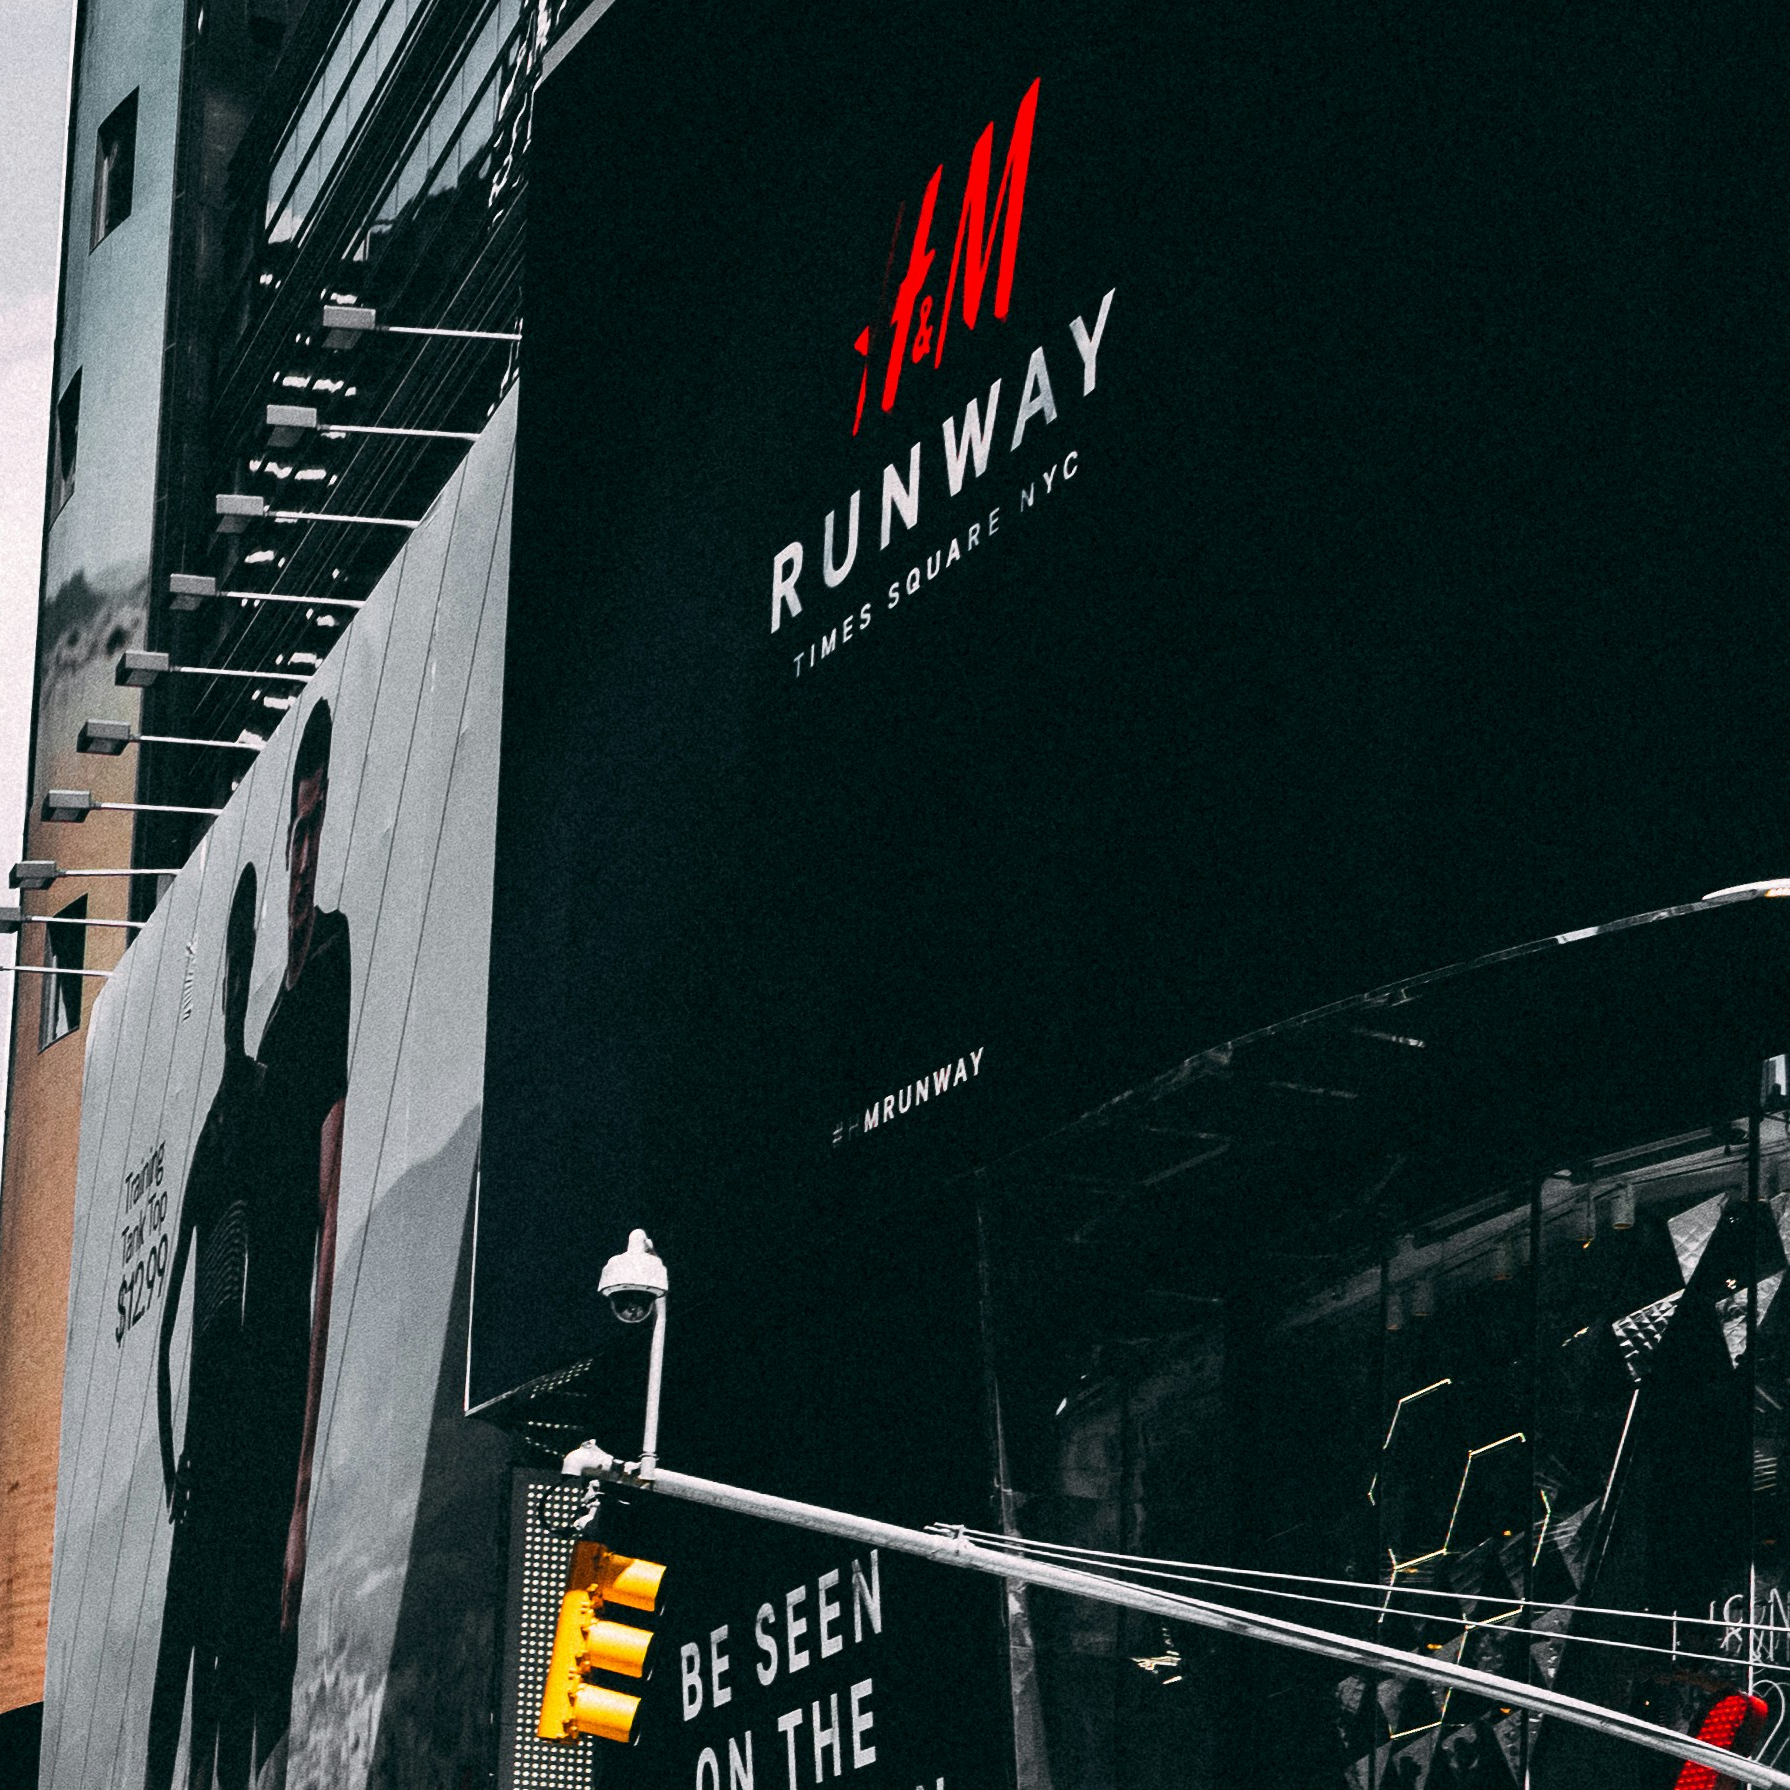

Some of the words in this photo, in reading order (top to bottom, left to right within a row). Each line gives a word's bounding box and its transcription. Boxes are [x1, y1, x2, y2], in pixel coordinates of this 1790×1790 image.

[851, 77, 1041, 436] H&M
[770, 287, 1116, 634] RUNWAY
[793, 604, 872, 678] TIMES
[887, 507, 1000, 610] SQUARE
[1019, 450, 1079, 513] NYC
[120, 1205, 149, 1268] Tank
[147, 1189, 168, 1239] Top
[124, 1140, 166, 1214] Training
[680, 1623, 731, 1724] BE
[755, 1548, 883, 1688] SEEN
[776, 1677, 877, 1788] THE
